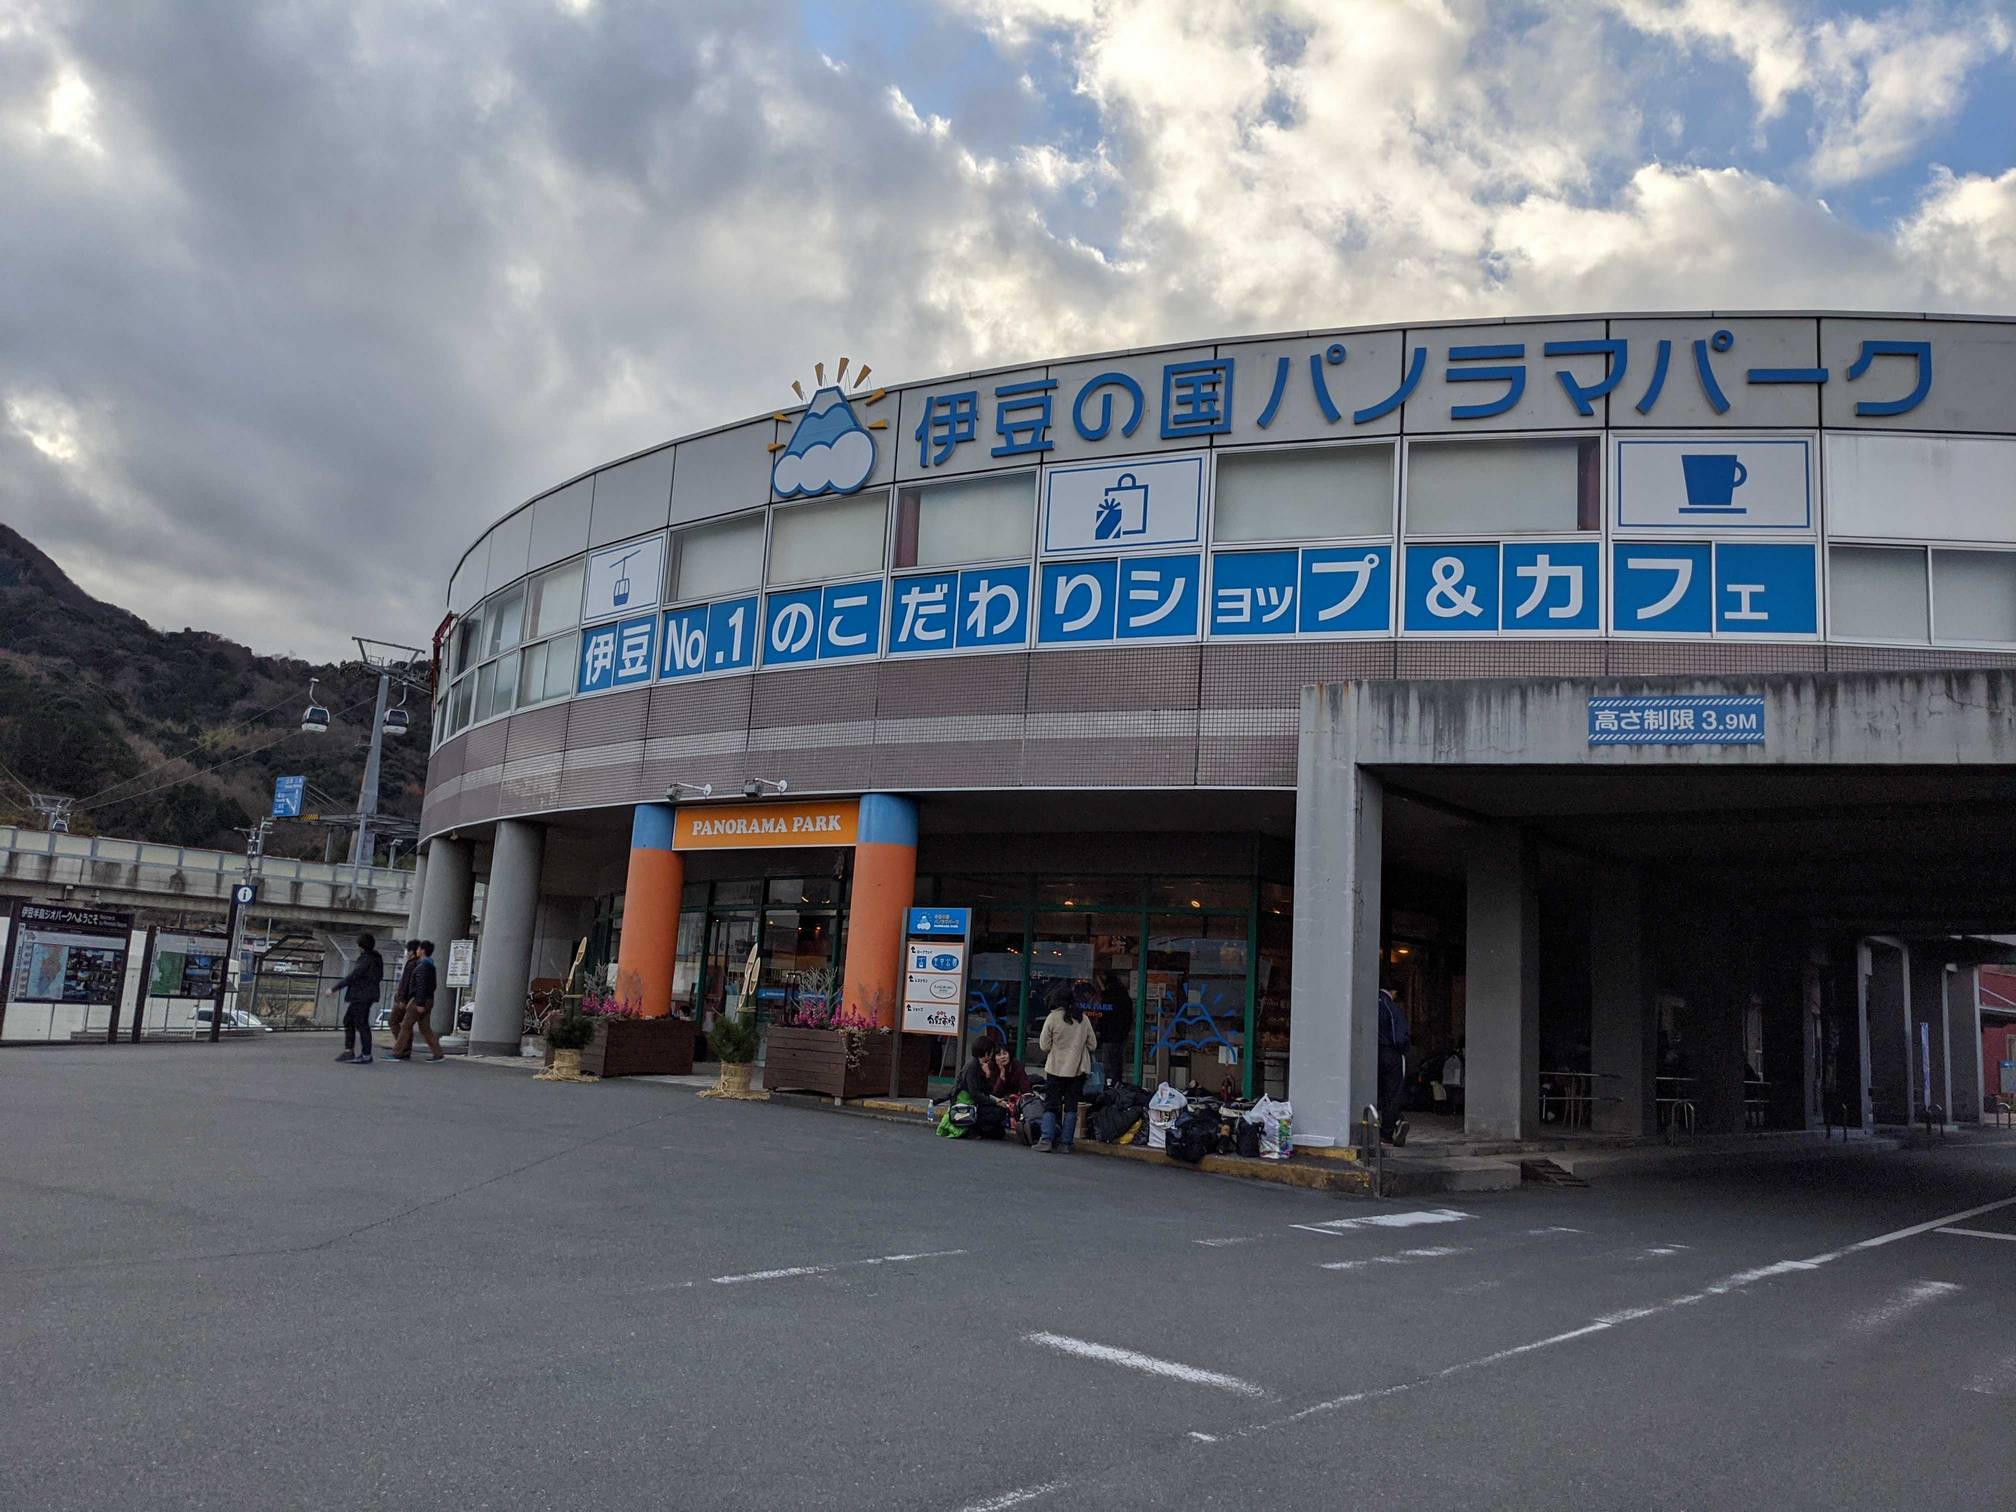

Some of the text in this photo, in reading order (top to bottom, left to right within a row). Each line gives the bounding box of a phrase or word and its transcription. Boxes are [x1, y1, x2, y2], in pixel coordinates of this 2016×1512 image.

[915, 329, 1932, 467] 伊豆の国パノラマパーク
[1594, 709, 1757, 731] 高さ制限 3.9M
[692, 815, 842, 836] PANORAMA PARK
